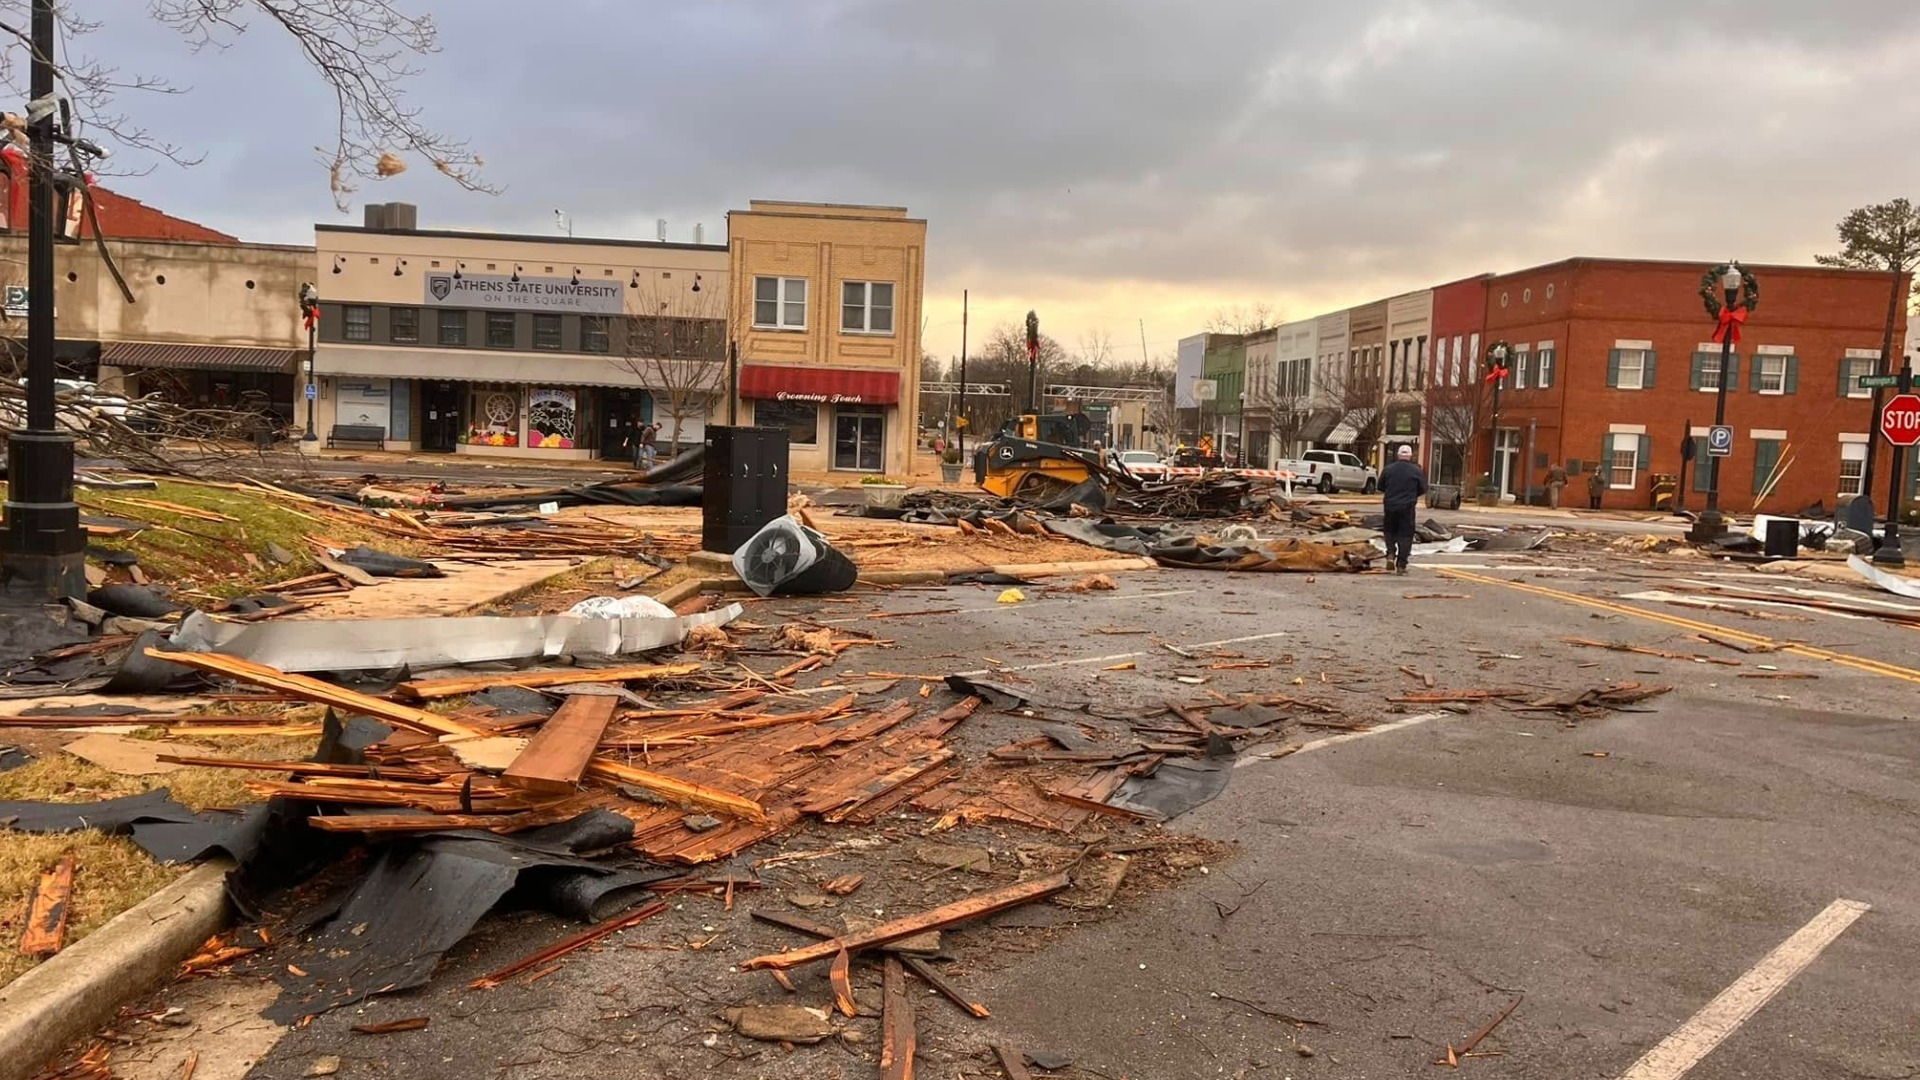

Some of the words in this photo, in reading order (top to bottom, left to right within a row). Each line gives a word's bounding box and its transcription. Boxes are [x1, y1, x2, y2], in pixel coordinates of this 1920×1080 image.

[454, 280, 504, 292] ATHENS
[506, 282, 542, 294] STATE
[545, 284, 618, 297] UNIVERSITY
[484, 294, 502, 303] ON
[507, 295, 529, 304] THE
[534, 296, 581, 307] SQUARE
[776, 391, 828, 403] Crowning
[830, 393, 862, 403] Touch
[1716, 430, 1727, 445] P
